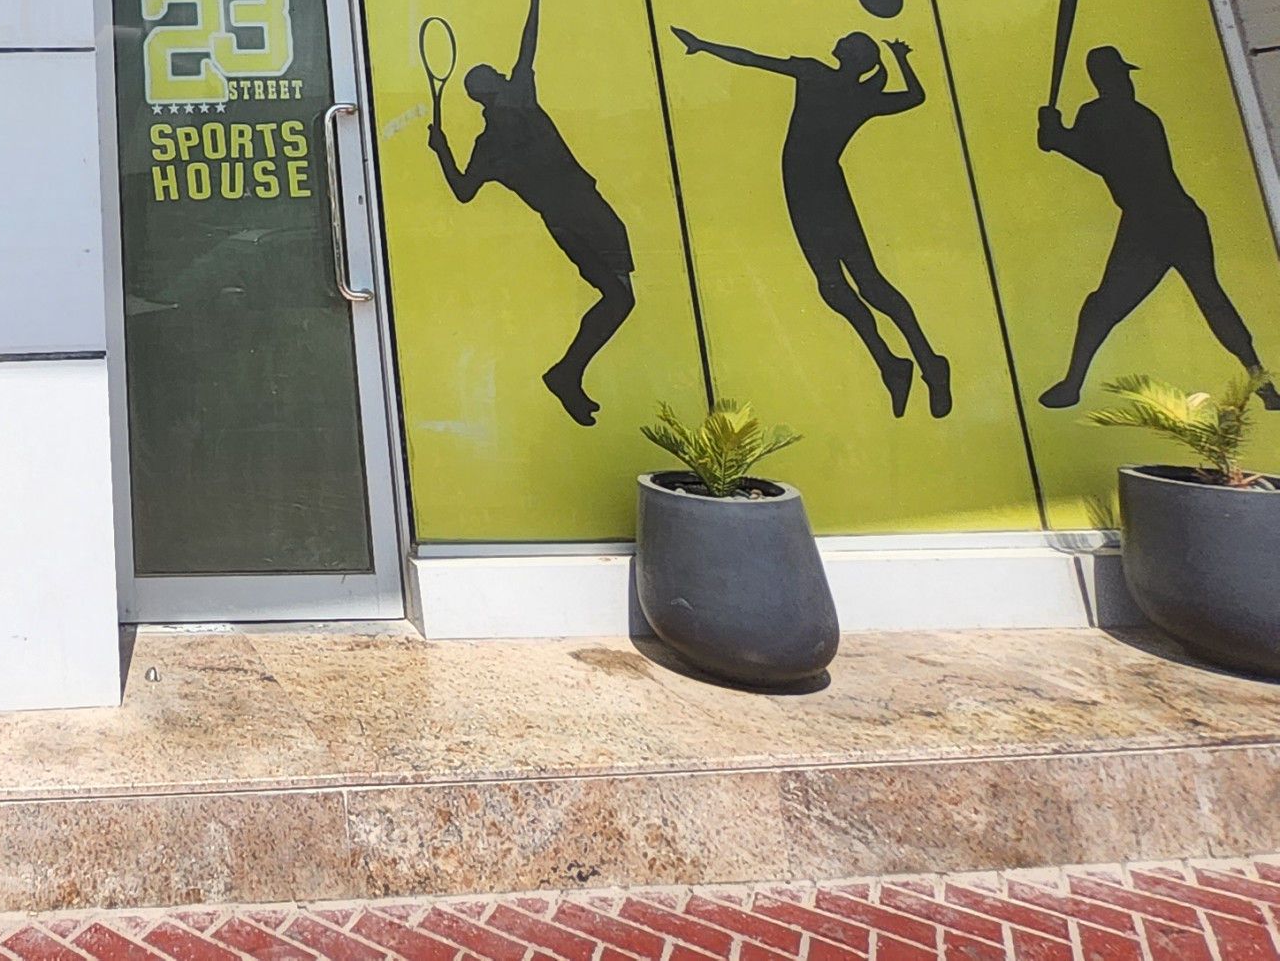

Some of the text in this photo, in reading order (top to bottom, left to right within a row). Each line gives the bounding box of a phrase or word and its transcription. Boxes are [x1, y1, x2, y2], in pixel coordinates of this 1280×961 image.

[228, 80, 302, 100] STREET
[150, 120, 308, 161] SPORTS
[151, 160, 312, 201] HOUSE
